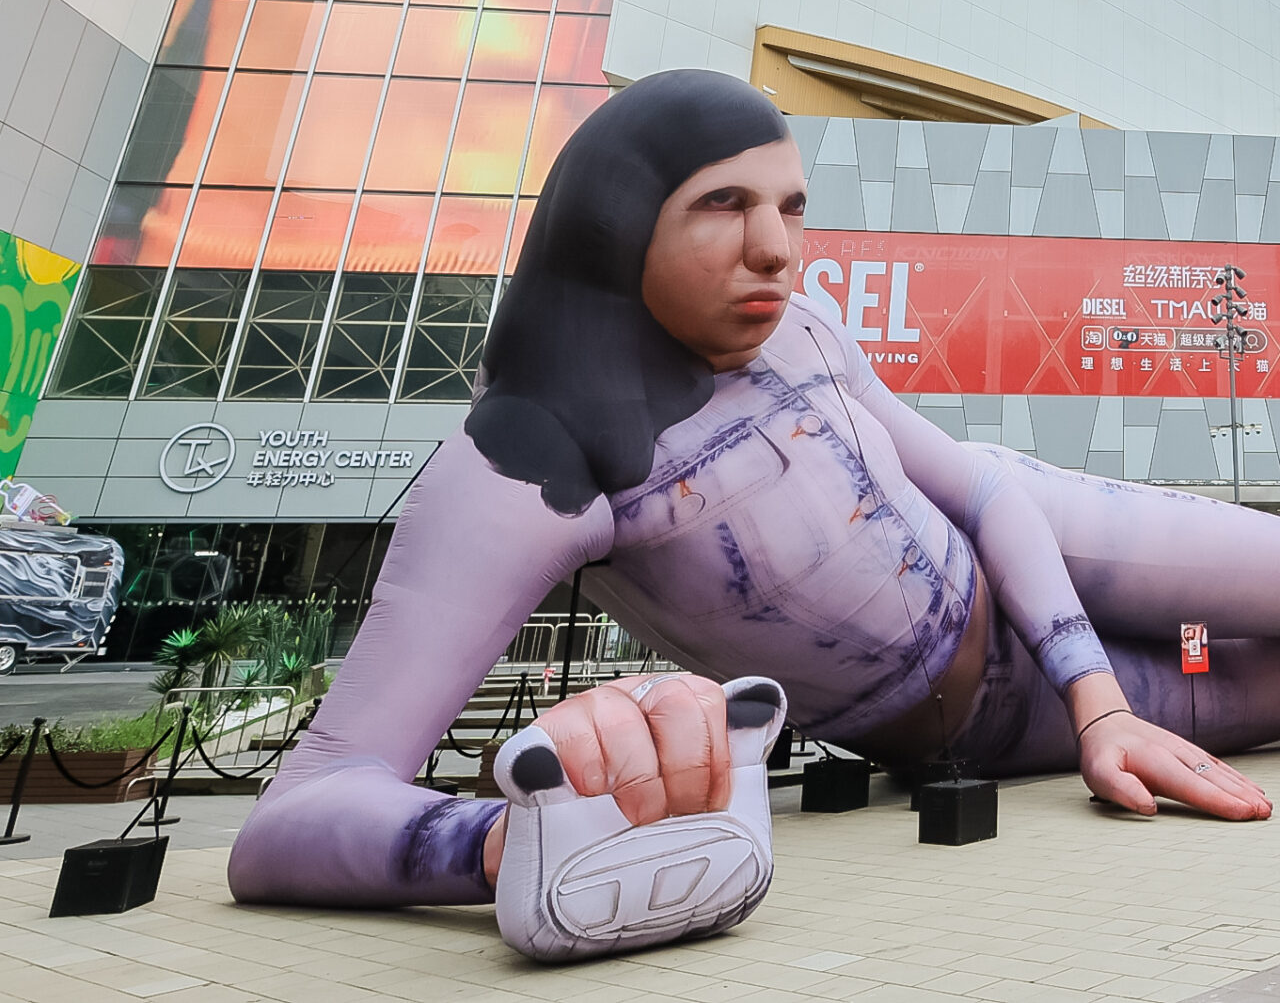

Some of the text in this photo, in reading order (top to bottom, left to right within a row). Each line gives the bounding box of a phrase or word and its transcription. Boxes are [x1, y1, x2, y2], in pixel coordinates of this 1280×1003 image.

[797, 257, 921, 342] SEL
[1082, 298, 1126, 315] DIESEL
[1140, 332, 1167, 346] 天猫
[867, 352, 919, 364] IVING
[258, 430, 331, 447] YOUTH
[252, 450, 414, 467] ENERGY CENTER
[246, 471, 336, 487] 年轻力中心
